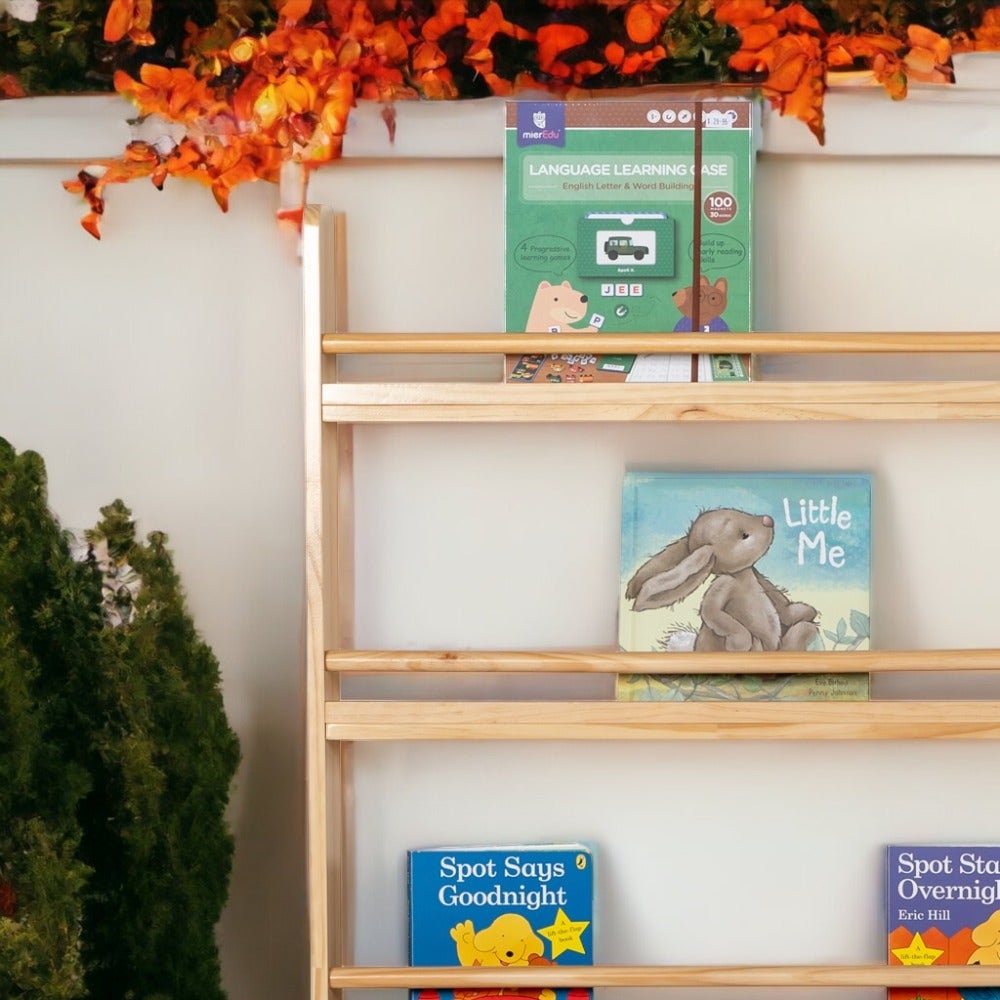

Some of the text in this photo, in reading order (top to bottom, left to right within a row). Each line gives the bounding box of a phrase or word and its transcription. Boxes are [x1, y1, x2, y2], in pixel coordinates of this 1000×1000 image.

[522, 130, 560, 140] mierEdu
[529, 164, 611, 176] LANGUAGE
[614, 164, 687, 176] LEARNING
[562, 182, 695, 191] English Letter & Word Building
[709, 196, 733, 208] 100
[520, 242, 528, 252] 4
[783, 496, 852, 529] Little
[798, 531, 846, 568] Me
[440, 856, 565, 882] Spot Says
[897, 852, 953, 879] Spot
[438, 884, 568, 911] Goodnight
[898, 909, 951, 921] Eric Hill
